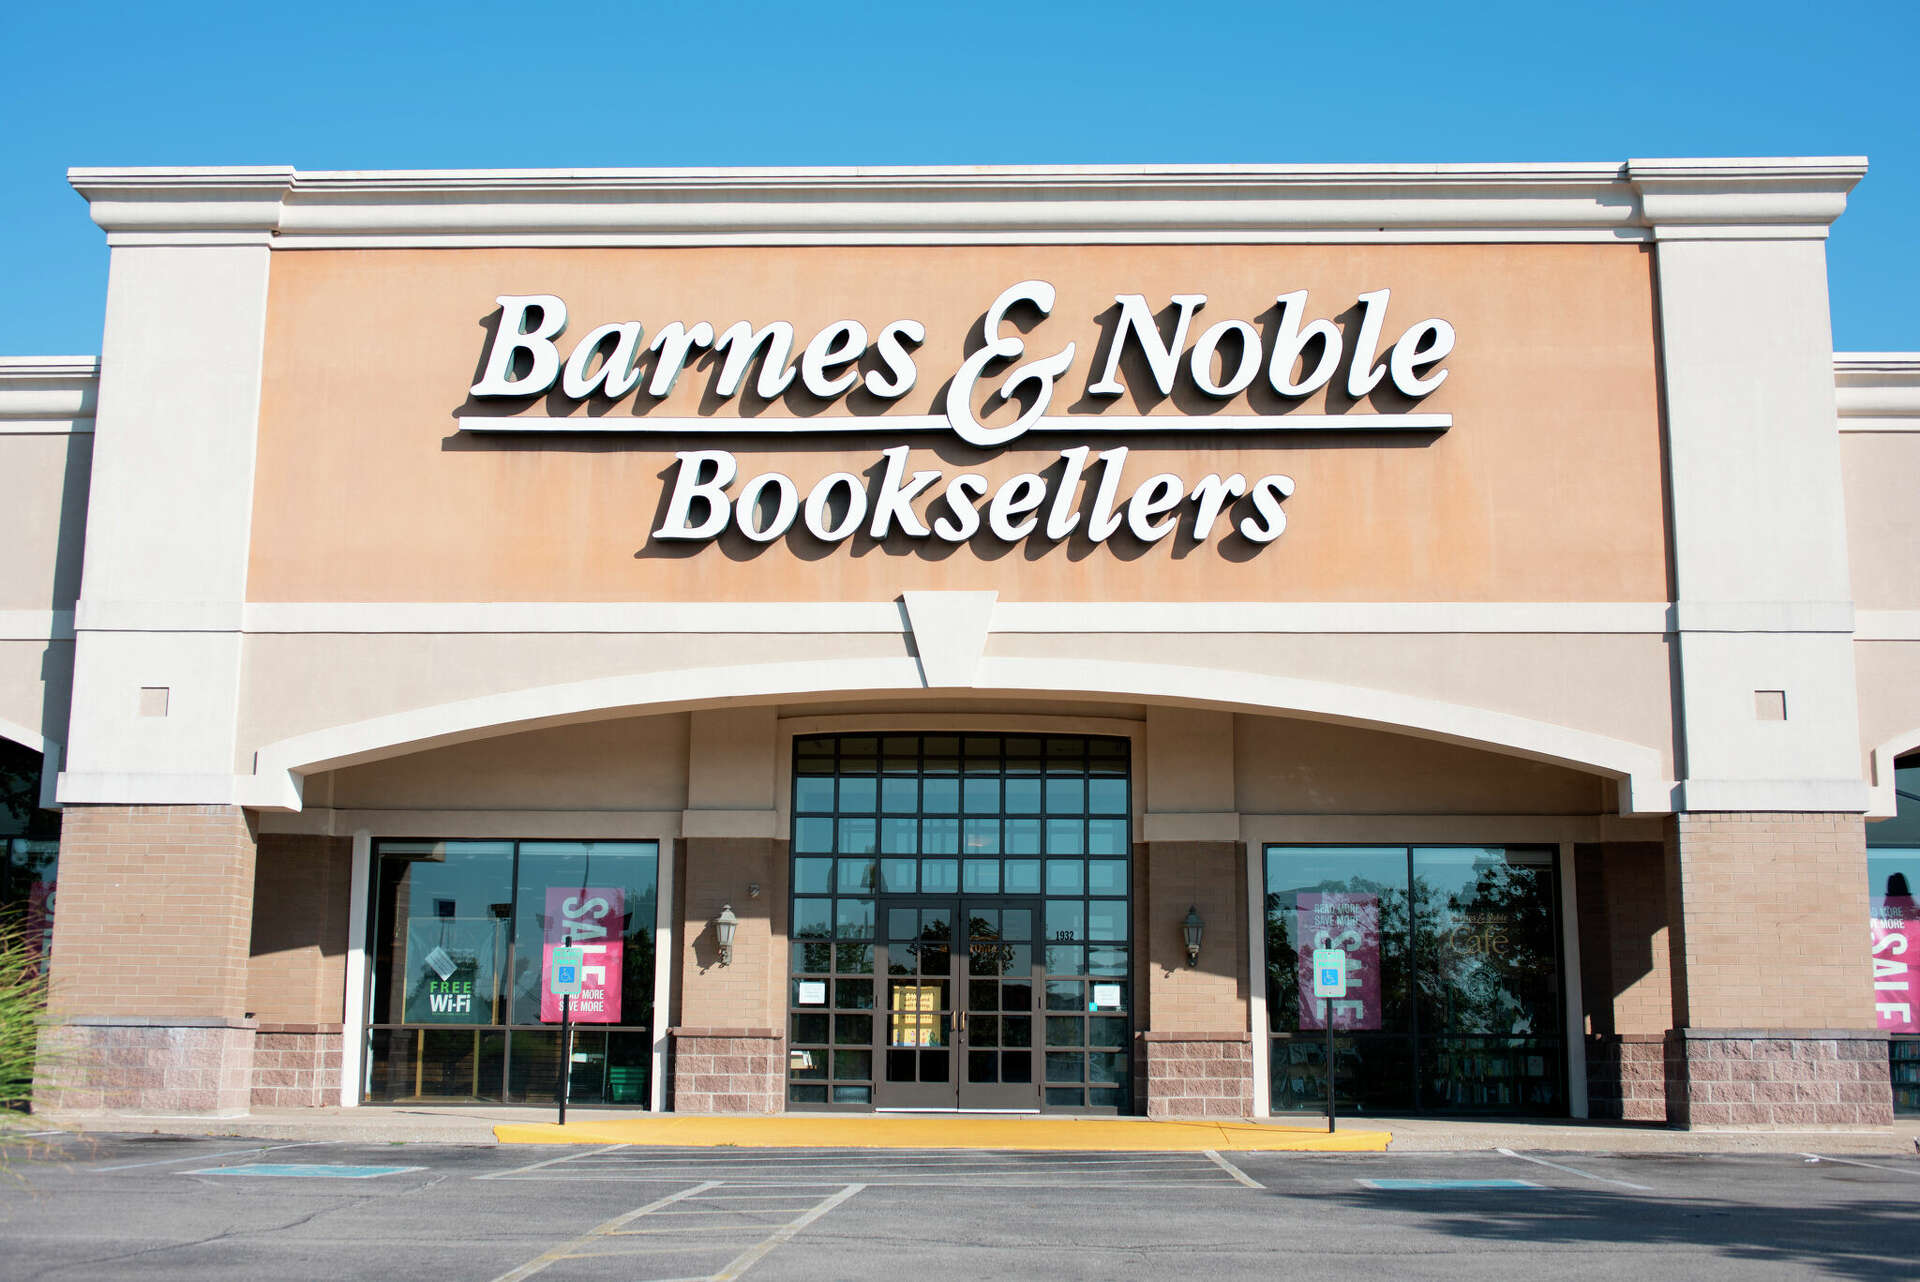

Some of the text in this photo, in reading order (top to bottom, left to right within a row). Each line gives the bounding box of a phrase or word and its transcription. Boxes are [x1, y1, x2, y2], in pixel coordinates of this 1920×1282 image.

[469, 279, 1457, 446] Barnes & Noble
[652, 445, 1296, 543] Booksellers
[1880, 919, 1905, 929] MORE
[1055, 931, 1075, 941] 1932
[430, 981, 472, 993] FREE
[582, 990, 605, 1000] MORE
[430, 993, 471, 1013] Wi-Fi
[559, 1000, 605, 1012] SVE MORE
